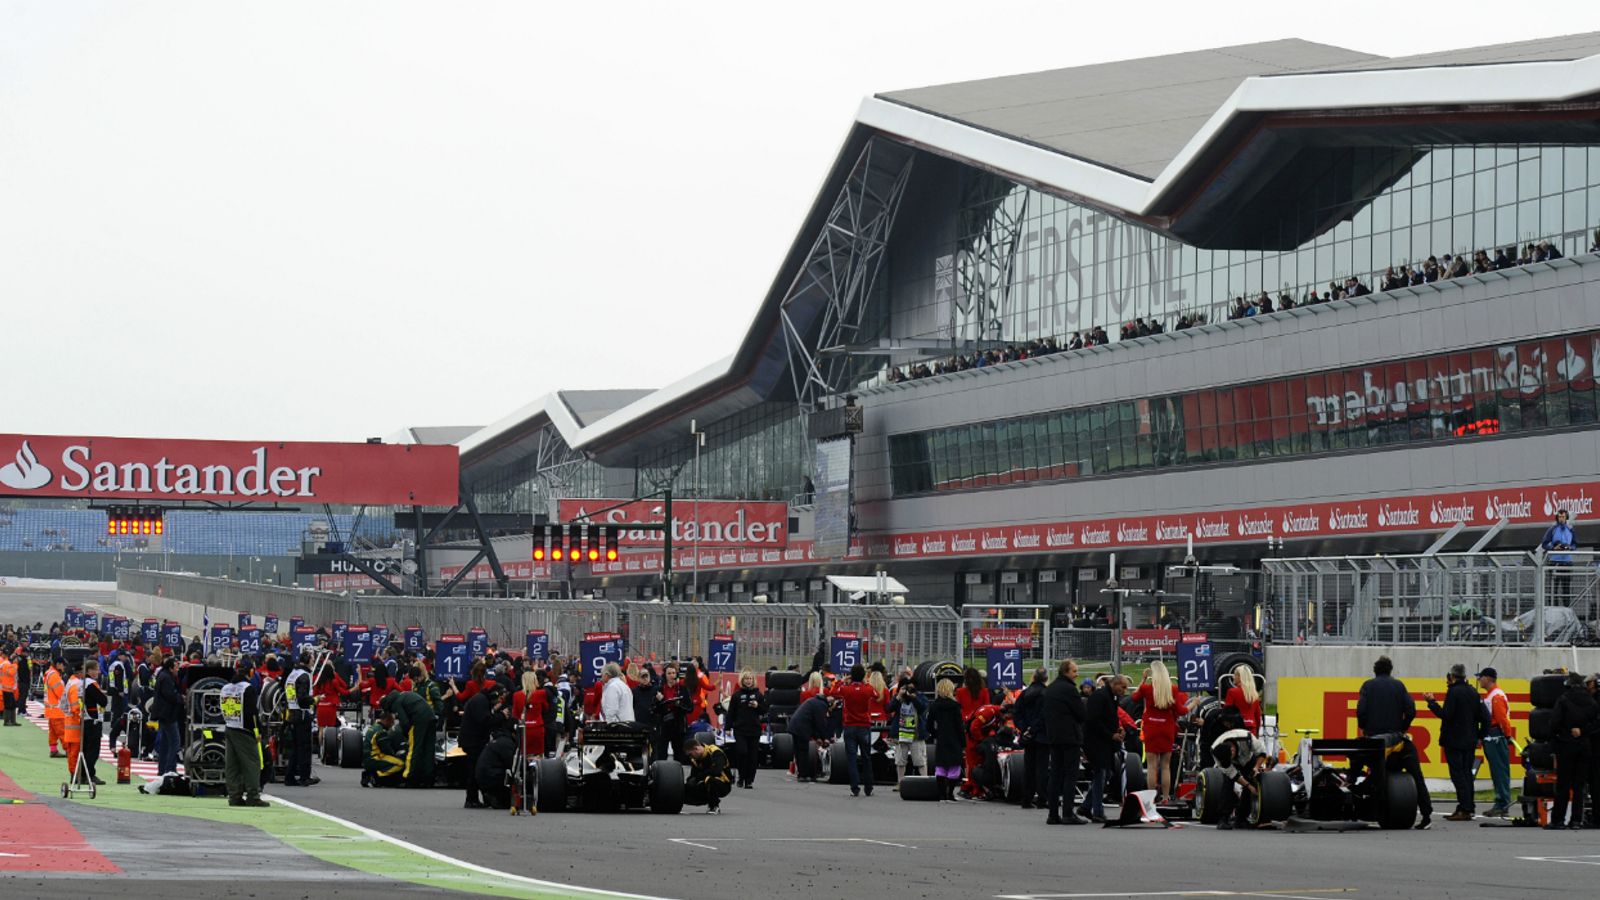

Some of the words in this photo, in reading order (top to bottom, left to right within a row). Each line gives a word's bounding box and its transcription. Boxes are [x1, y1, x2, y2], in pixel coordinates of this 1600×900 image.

[61, 445, 320, 497] Santander
[1244, 512, 1273, 535] Santander
[1289, 508, 1320, 532] Santander
[1335, 505, 1368, 529] Santander
[1384, 501, 1419, 526] Santander
[1437, 497, 1475, 523] Santander
[1493, 493, 1531, 519] Santander
[1552, 489, 1593, 515] Santander
[145, 629, 157, 639] 18
[165, 633, 179, 643] 16
[213, 636, 230, 647] 22
[409, 636, 418, 647] 6
[1127, 635, 1179, 647] Santander
[240, 639, 259, 652] 24
[352, 642, 363, 658] 7
[472, 640, 481, 652] 5
[533, 642, 542, 655] 2
[443, 655, 461, 673] 11
[592, 656, 607, 676] 9
[713, 651, 731, 666] 17
[835, 650, 855, 667] 15
[992, 661, 1017, 680] 14
[1184, 659, 1209, 681] 21
